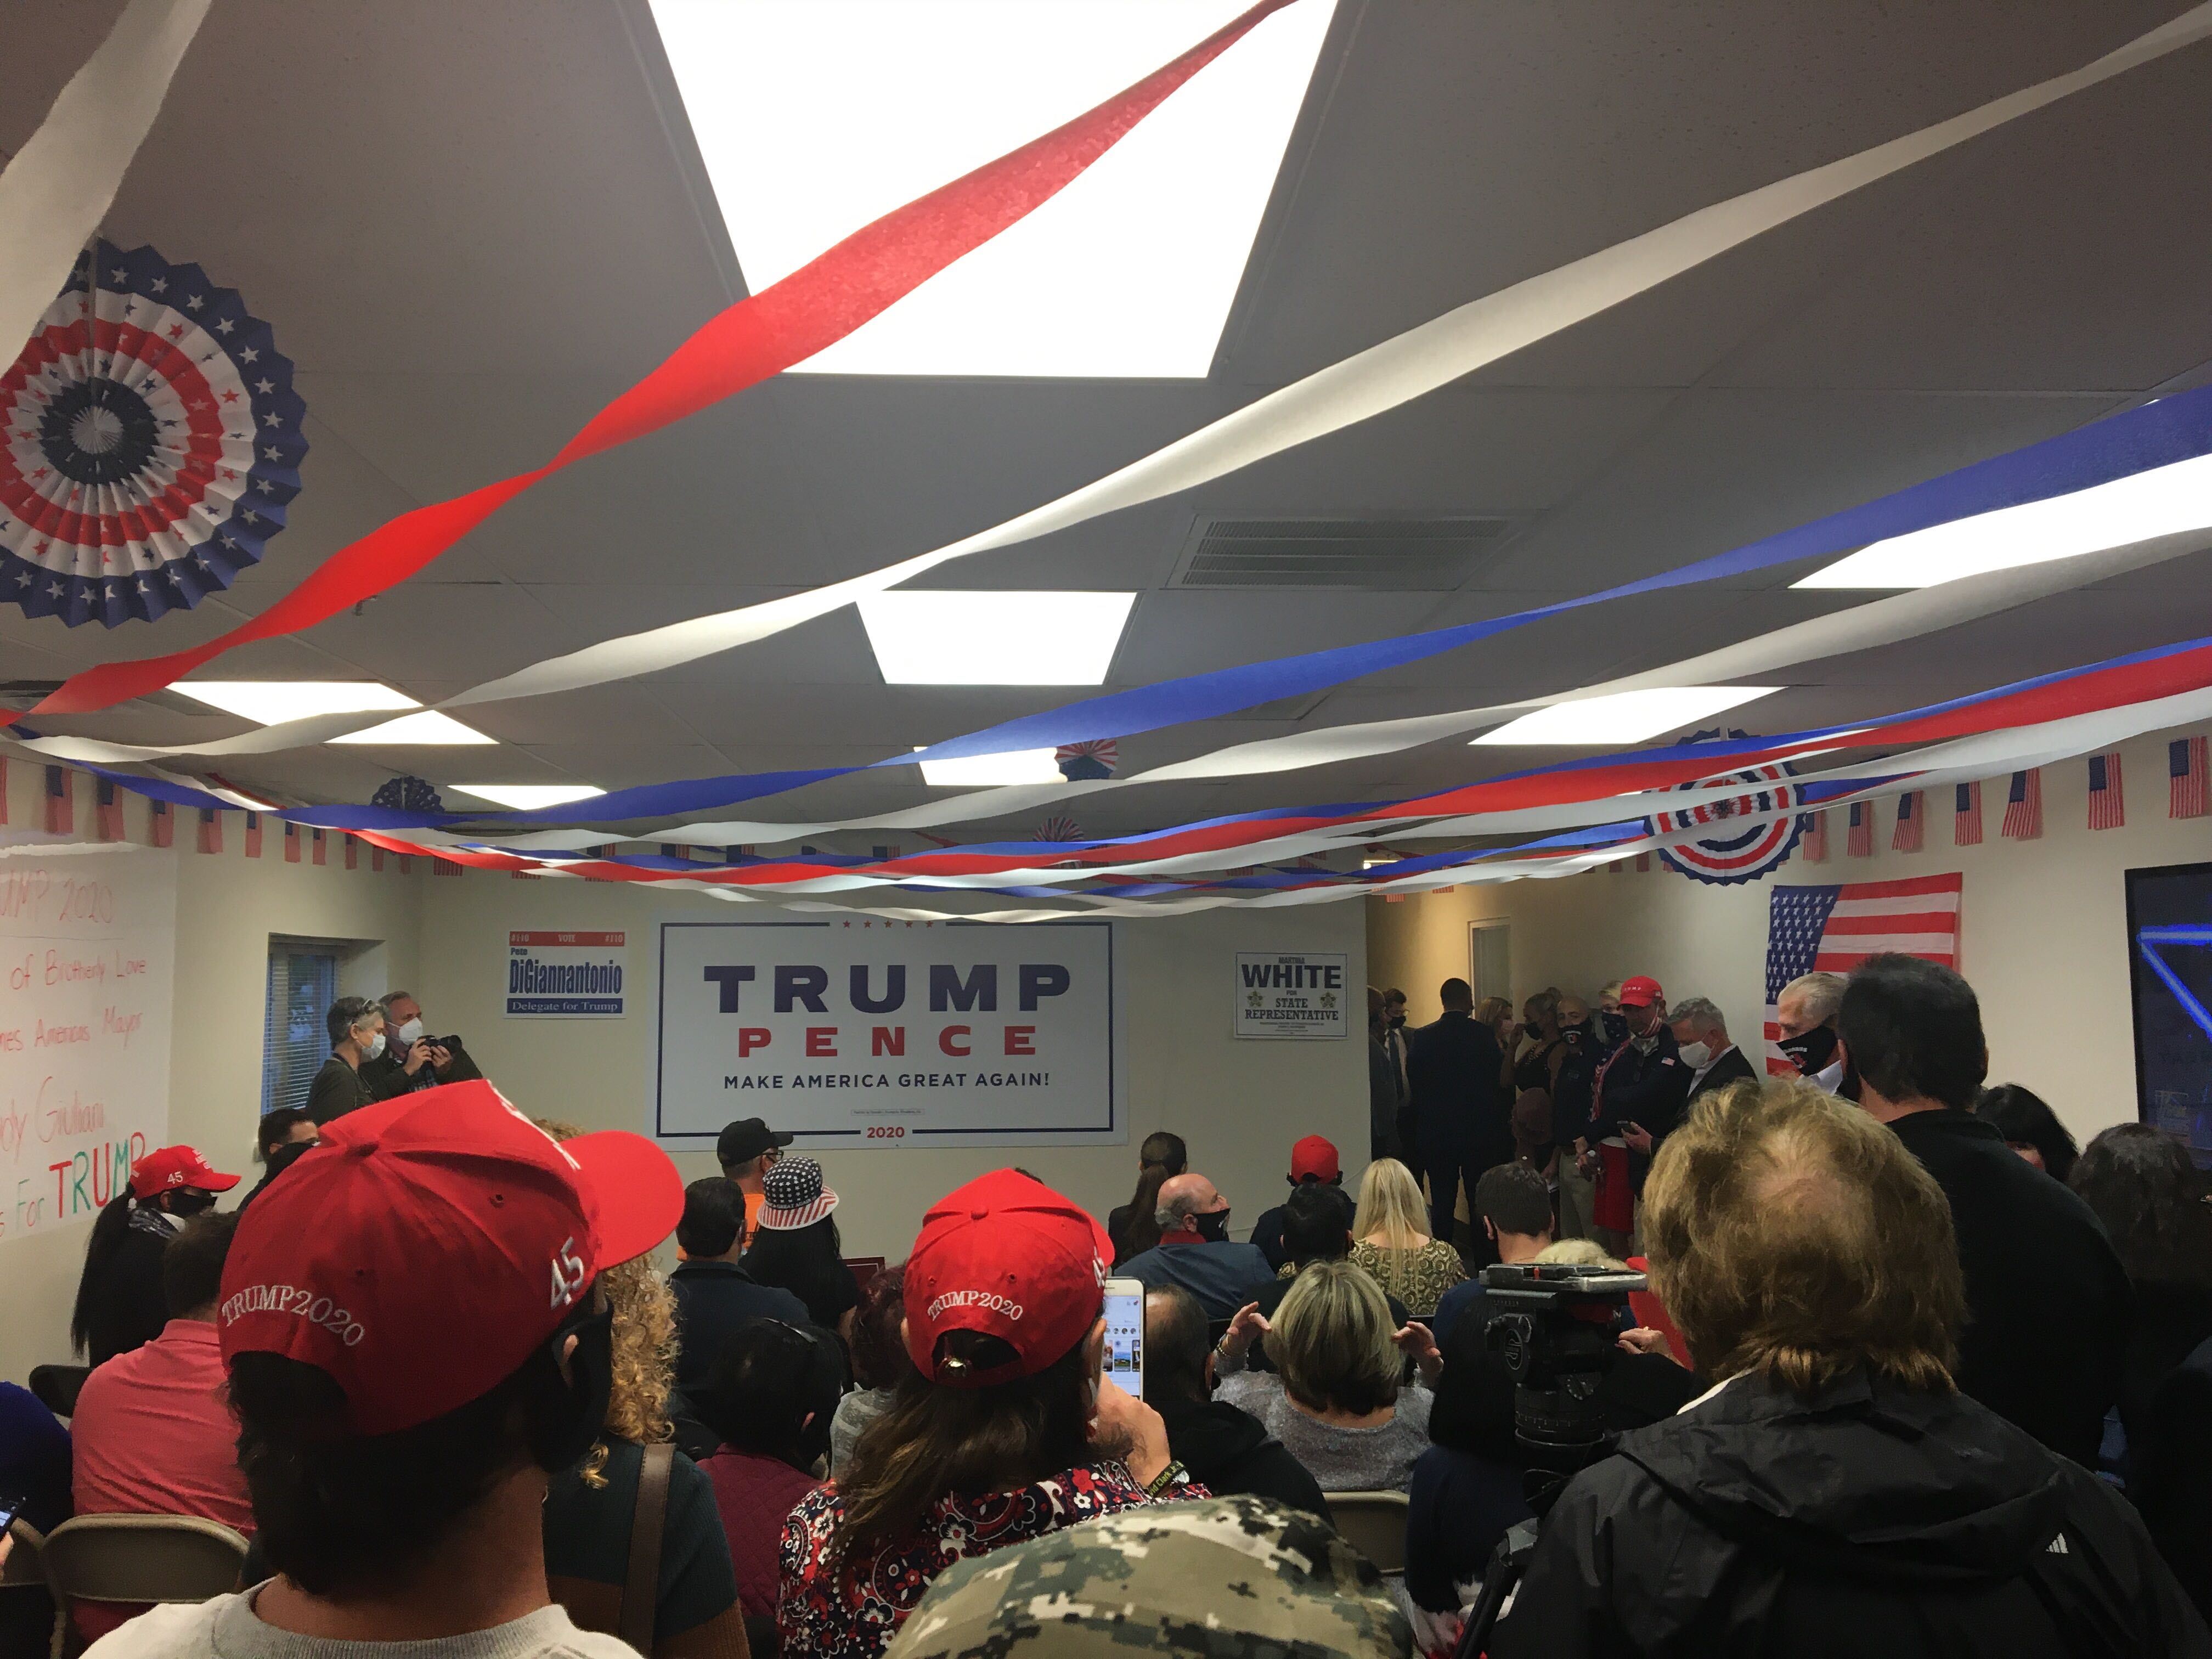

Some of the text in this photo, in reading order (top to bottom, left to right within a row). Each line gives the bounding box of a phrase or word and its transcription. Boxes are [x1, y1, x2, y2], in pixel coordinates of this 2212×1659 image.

[59, 878, 112, 924] 2020
[510, 947, 528, 956] Pete
[558, 934, 575, 943] VOTE
[605, 934, 623, 943] #110
[10, 953, 33, 990] of
[509, 959, 622, 994] DiGiannantonio
[1242, 964, 1342, 989] WHITE
[703, 964, 1071, 1014] TRUMP
[1276, 998, 1308, 1008] STATE
[512, 1001, 618, 1012] Delegate for Trump
[1245, 1009, 1339, 1020] REPRESENTATIVE
[101, 1006, 143, 1051] Mayor
[738, 1025, 1037, 1058] PENCE
[724, 1072, 1050, 1089] MAKE AMERICA GREAT AGAIN!
[867, 1126, 905, 1138] 2020
[15, 1132, 145, 1231] For TRUMP
[167, 1171, 183, 1184] 45
[551, 1236, 584, 1310] 45
[222, 1285, 365, 1346] TRUMP2020
[928, 1290, 1024, 1321] TRUMP2020
[1155, 1471, 1172, 1487] Clark
